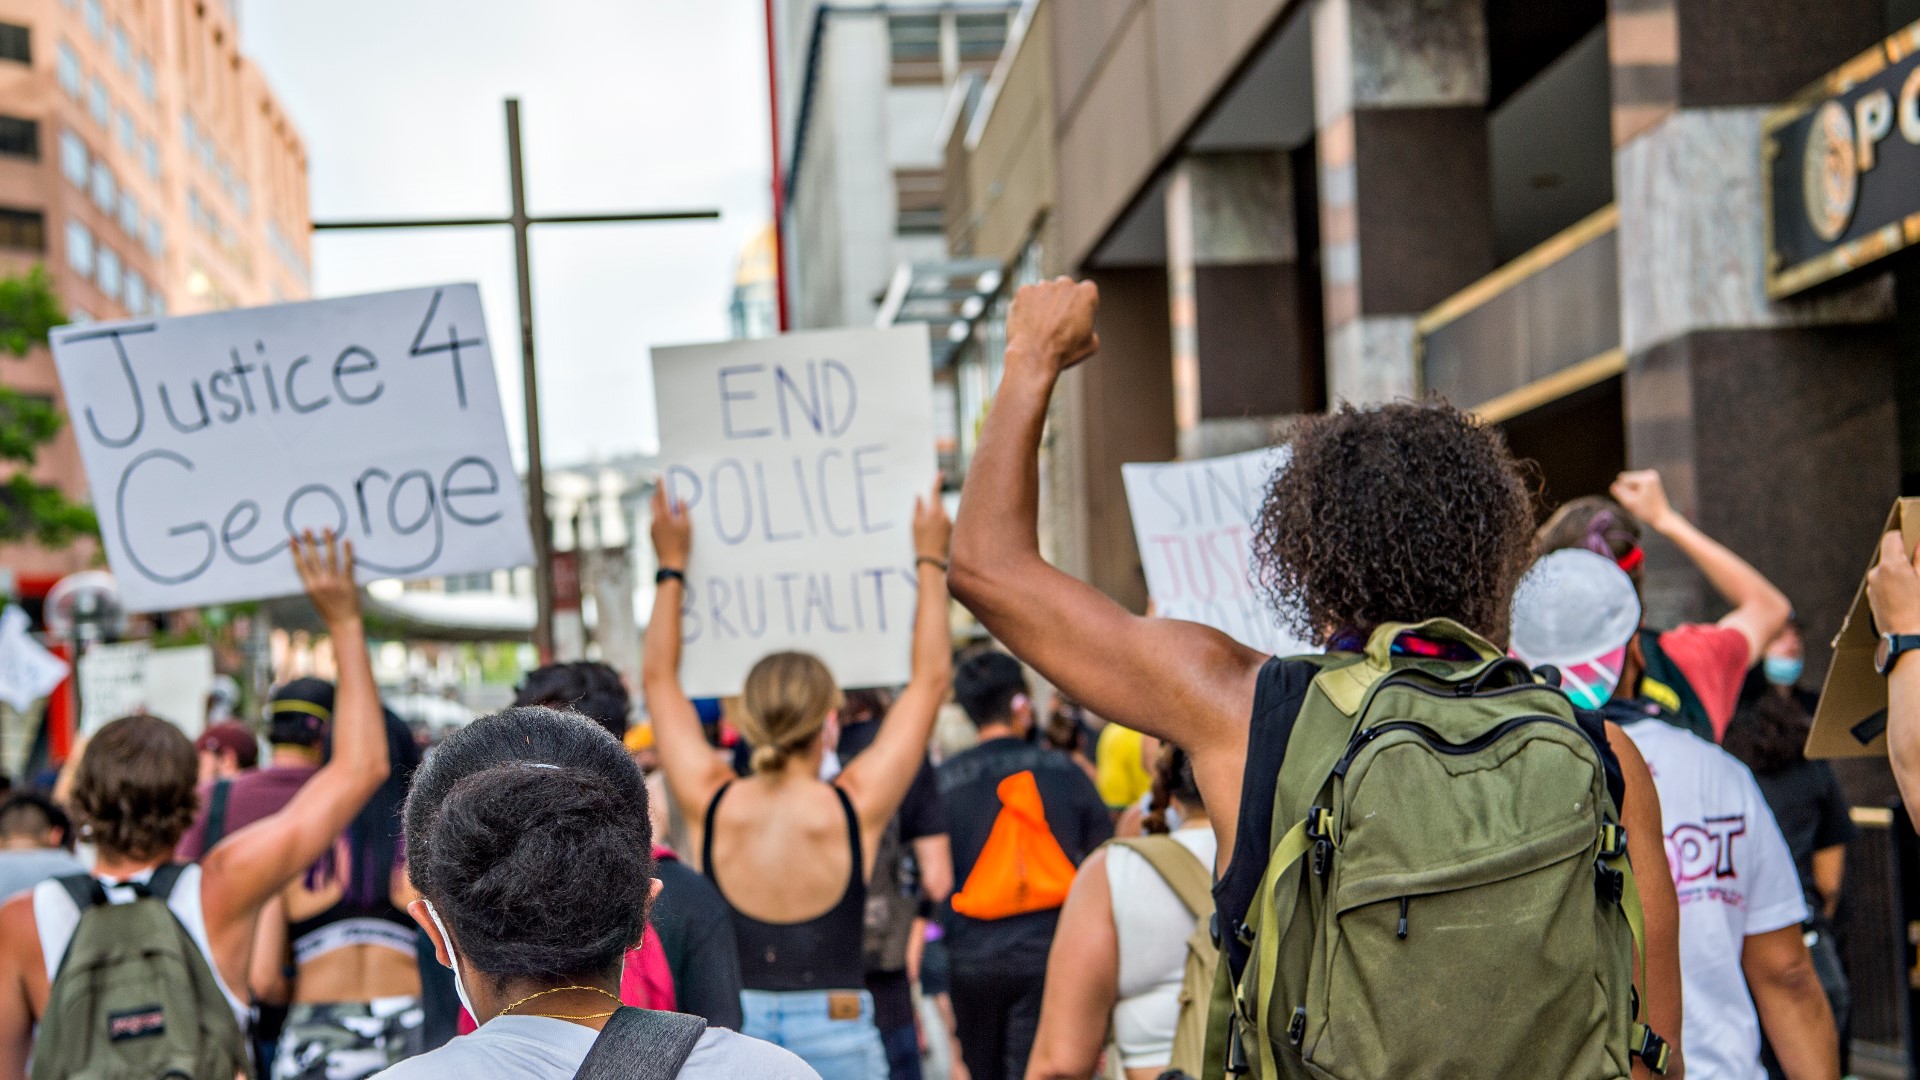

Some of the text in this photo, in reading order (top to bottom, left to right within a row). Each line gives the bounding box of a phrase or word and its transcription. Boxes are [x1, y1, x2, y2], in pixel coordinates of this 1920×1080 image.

[61, 289, 483, 449] Justice 4
[717, 358, 858, 440] END
[115, 447, 503, 586] George
[664, 442, 896, 546] POLICE
[1149, 522, 1260, 604] JUST
